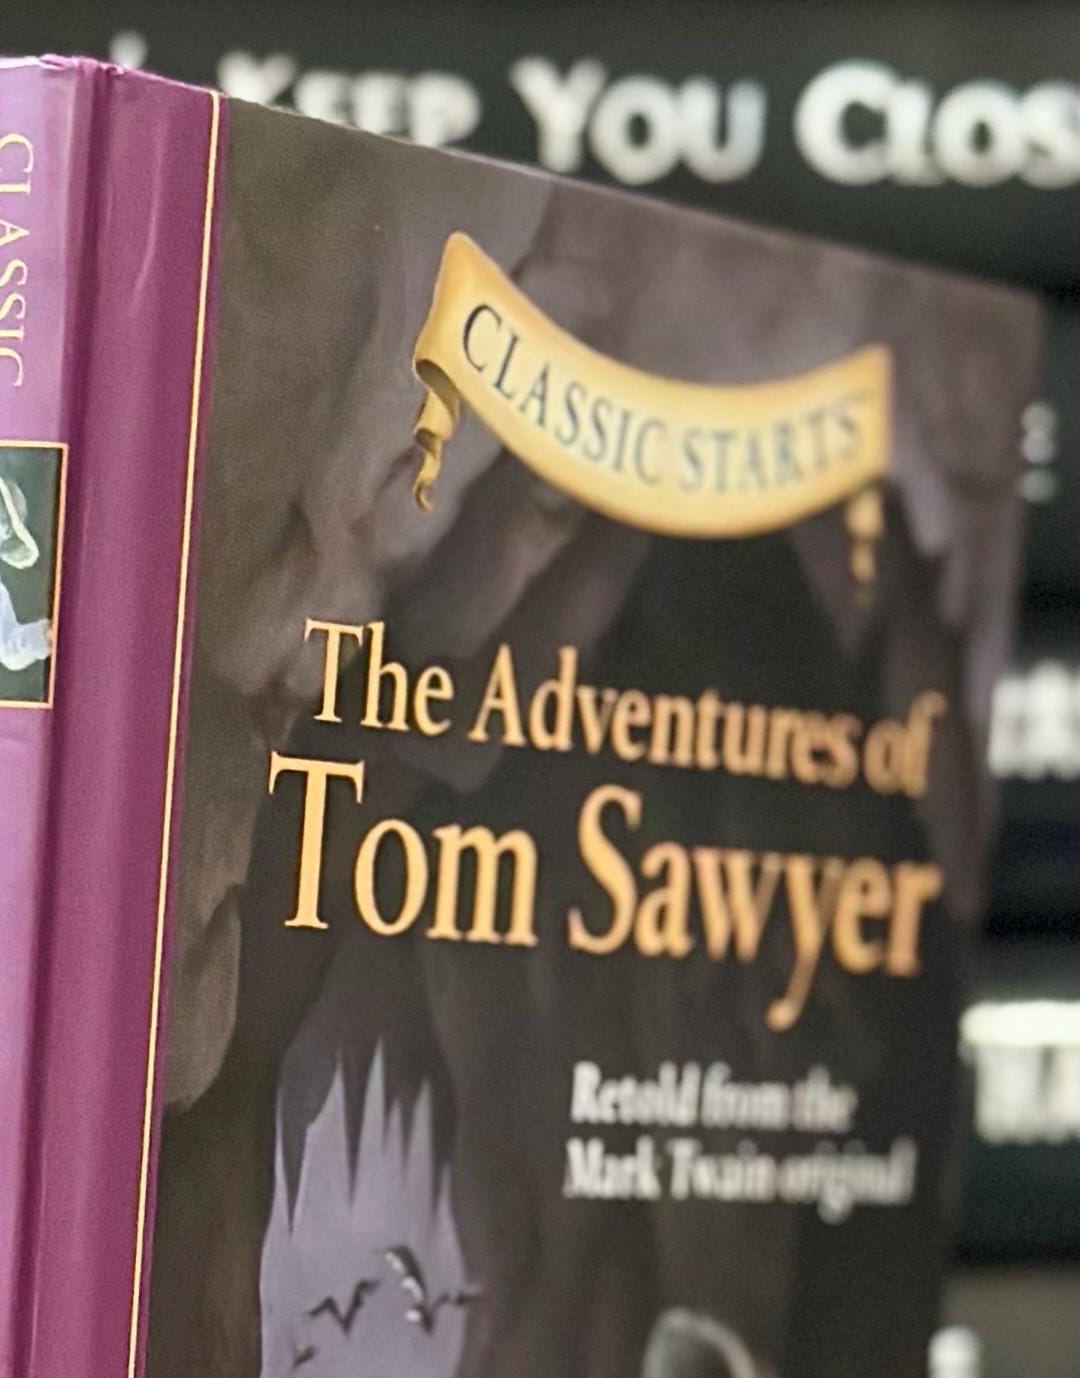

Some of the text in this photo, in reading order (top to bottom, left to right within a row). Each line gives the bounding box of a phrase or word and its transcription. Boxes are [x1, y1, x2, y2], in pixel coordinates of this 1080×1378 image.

[510, 55, 766, 192] YOU
[462, 303, 668, 487] CLASSIC
[679, 388, 868, 496] STARTS
[305, 617, 453, 736] The
[468, 643, 861, 789] Adventures
[864, 690, 947, 799] of
[268, 751, 945, 1032] Tom Sawyer
[570, 1060, 700, 1126] Retold
[563, 1135, 917, 1225] Mark Twain original
